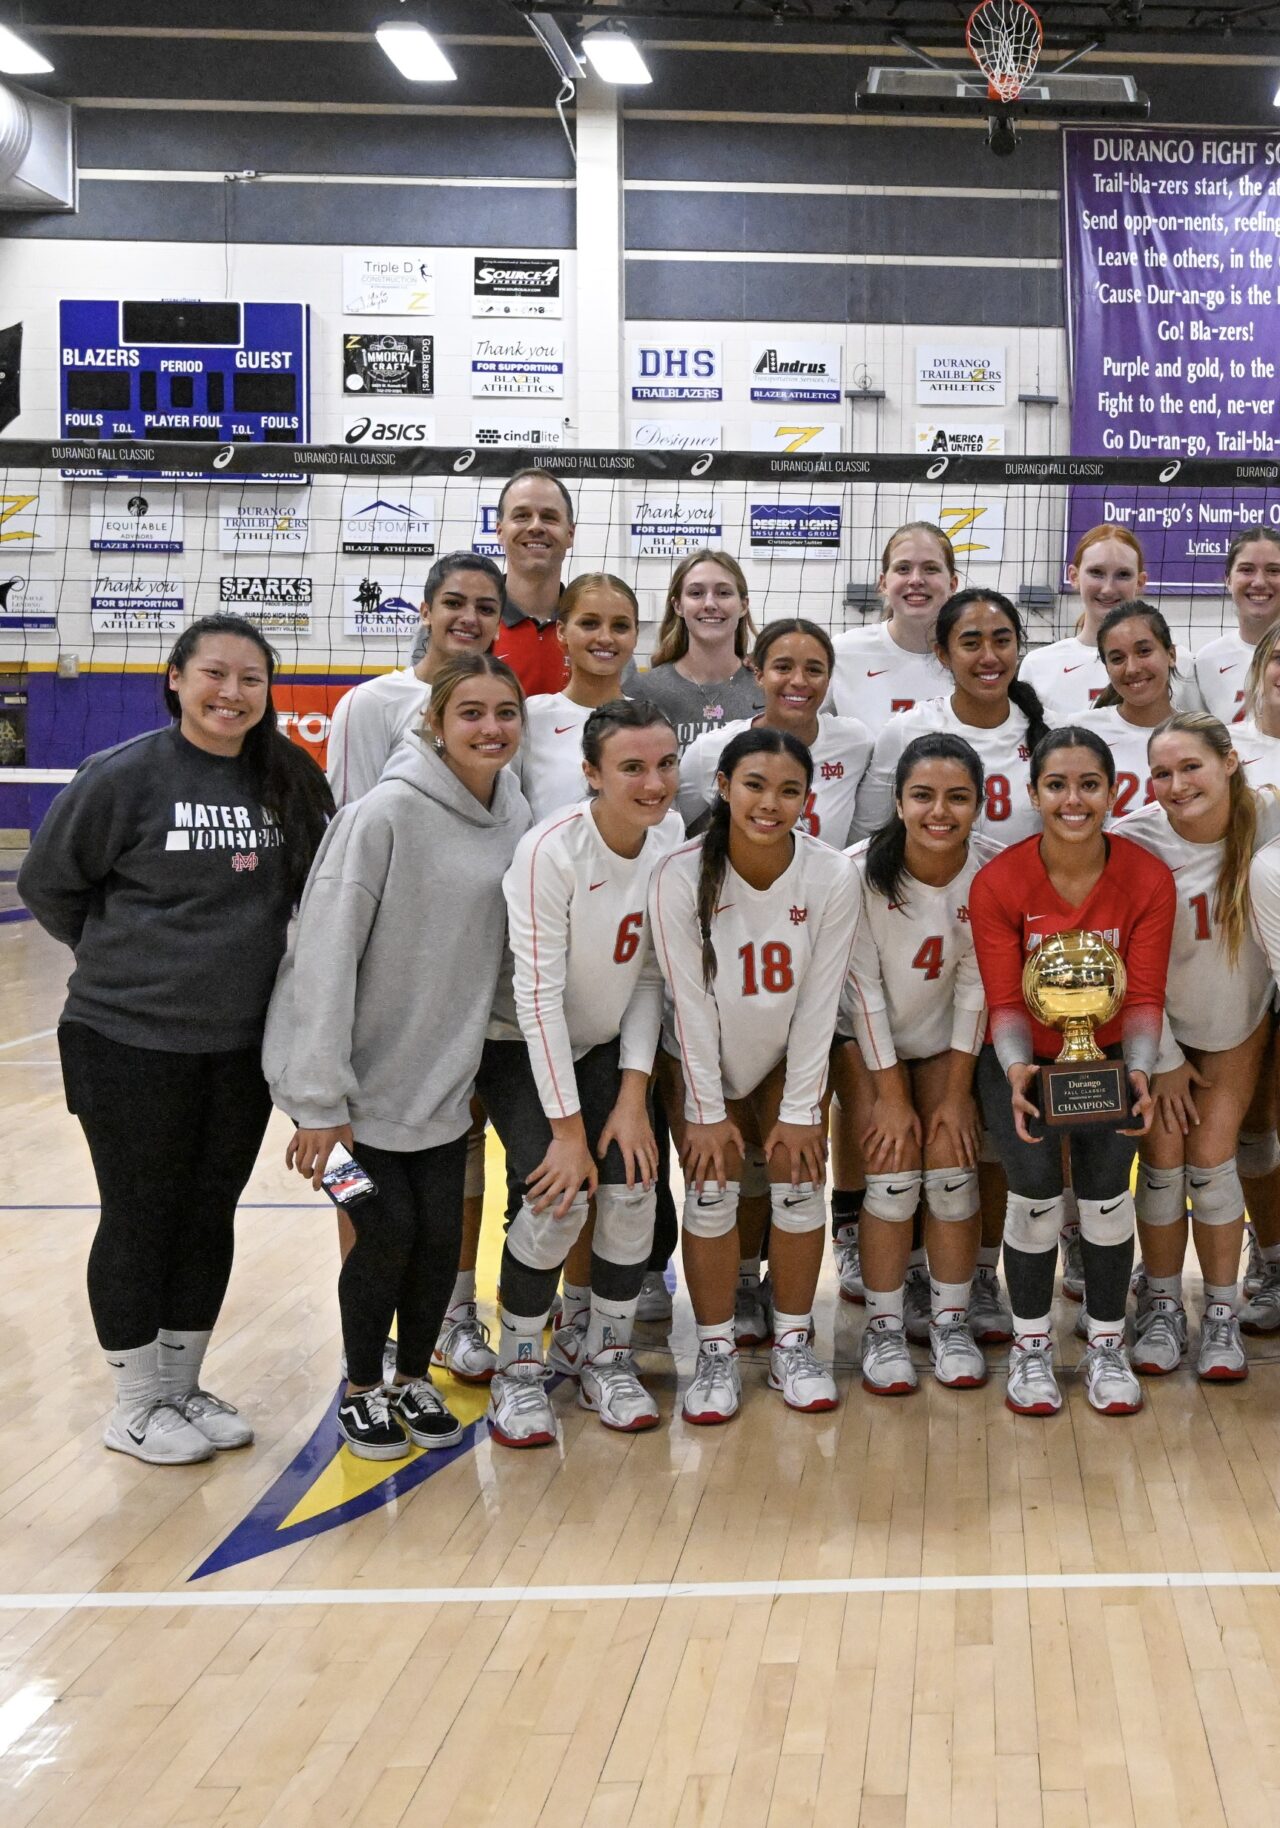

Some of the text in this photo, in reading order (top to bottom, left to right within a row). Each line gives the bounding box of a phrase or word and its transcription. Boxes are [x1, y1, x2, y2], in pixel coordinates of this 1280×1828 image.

[1093, 138, 1194, 164] DURANGO
[1202, 141, 1257, 165] FIGHT
[1093, 173, 1188, 195] Trail-bla-zers
[1194, 178, 1233, 198] start,
[1239, 177, 1262, 196] the
[1082, 209, 1117, 230] Send
[1124, 214, 1229, 236] opp-on-nents,
[1098, 246, 1138, 267] Leave
[1144, 247, 1168, 268] the
[1173, 249, 1225, 272] others,
[1230, 248, 1244, 268] in
[1249, 248, 1273, 269] the
[364, 261, 399, 275] Triple
[1094, 281, 1142, 304] 'Cause
[1147, 284, 1225, 311] Dur-an-go
[1230, 284, 1242, 305] is
[1248, 284, 1271, 305] the
[1157, 321, 1254, 341] Go! Bla-zers!
[476, 340, 557, 361] Thank you
[63, 349, 292, 368] BLAZERS GUEST
[362, 349, 416, 367] IMMORTAL
[640, 350, 714, 377] DHS
[753, 349, 827, 374] Andrus
[933, 358, 990, 368] DURANGO
[161, 361, 203, 372] PERIOD
[477, 363, 558, 372] FOR SUPPORTING
[1103, 356, 1150, 382] Purple
[1154, 357, 1182, 378] and
[1187, 357, 1225, 383] gold,
[1230, 360, 1245, 378] to
[1250, 358, 1275, 378] the
[494, 375, 541, 384] BLAZER
[920, 369, 1002, 381] TRAILBLAZERS
[481, 384, 555, 393] ATHLETICS
[635, 388, 719, 399] TRAILBLAZERS
[929, 384, 995, 392] ATHLETICS
[787, 392, 837, 400] ATHLETICS
[1098, 392, 1134, 418] Fight
[1139, 396, 1155, 414] to
[1160, 394, 1184, 414] the
[1189, 394, 1222, 418] end,
[1227, 398, 1275, 415] ne-ver
[65, 414, 103, 426] FOULS
[145, 415, 222, 427] PLAYER FOUL
[261, 417, 299, 429] FOULS
[372, 423, 427, 441] asics
[634, 424, 719, 450] Designer
[1103, 429, 1124, 449] Go
[1129, 430, 1211, 456] Du-ran-go,
[52, 447, 155, 461] DURANGO FALL CLASSIC
[534, 456, 635, 469] DURANGO FALL CLASSIC
[237, 507, 296, 516] DURANGO
[636, 504, 716, 523] Thank you
[1104, 502, 1193, 528] Dur-an-go's
[1199, 503, 1264, 525] Num-ber
[106, 522, 167, 531] EQUITABLE
[224, 517, 308, 529] TRAILBLAZERS
[752, 519, 838, 531] DESERT LIGHTS
[232, 532, 301, 541] ATHLETICS
[636, 526, 717, 535] FOR SUPPORTING
[653, 537, 699, 546] BLAZER
[1188, 539, 1220, 556] Lyrics
[384, 545, 432, 553] ATHLETICS
[95, 578, 177, 597] Thank you
[221, 577, 311, 596] SPARKS
[96, 600, 179, 609] FOR SUPPORTING
[101, 621, 176, 630] ATHLETICS
[986, 774, 1011, 821] 8
[175, 802, 251, 828] MATER
[613, 911, 644, 964] 6
[912, 935, 944, 980] 4
[738, 941, 794, 996] 18
[1068, 1080, 1101, 1089] Durango
[1058, 1100, 1115, 1112] CHAMPIONS
